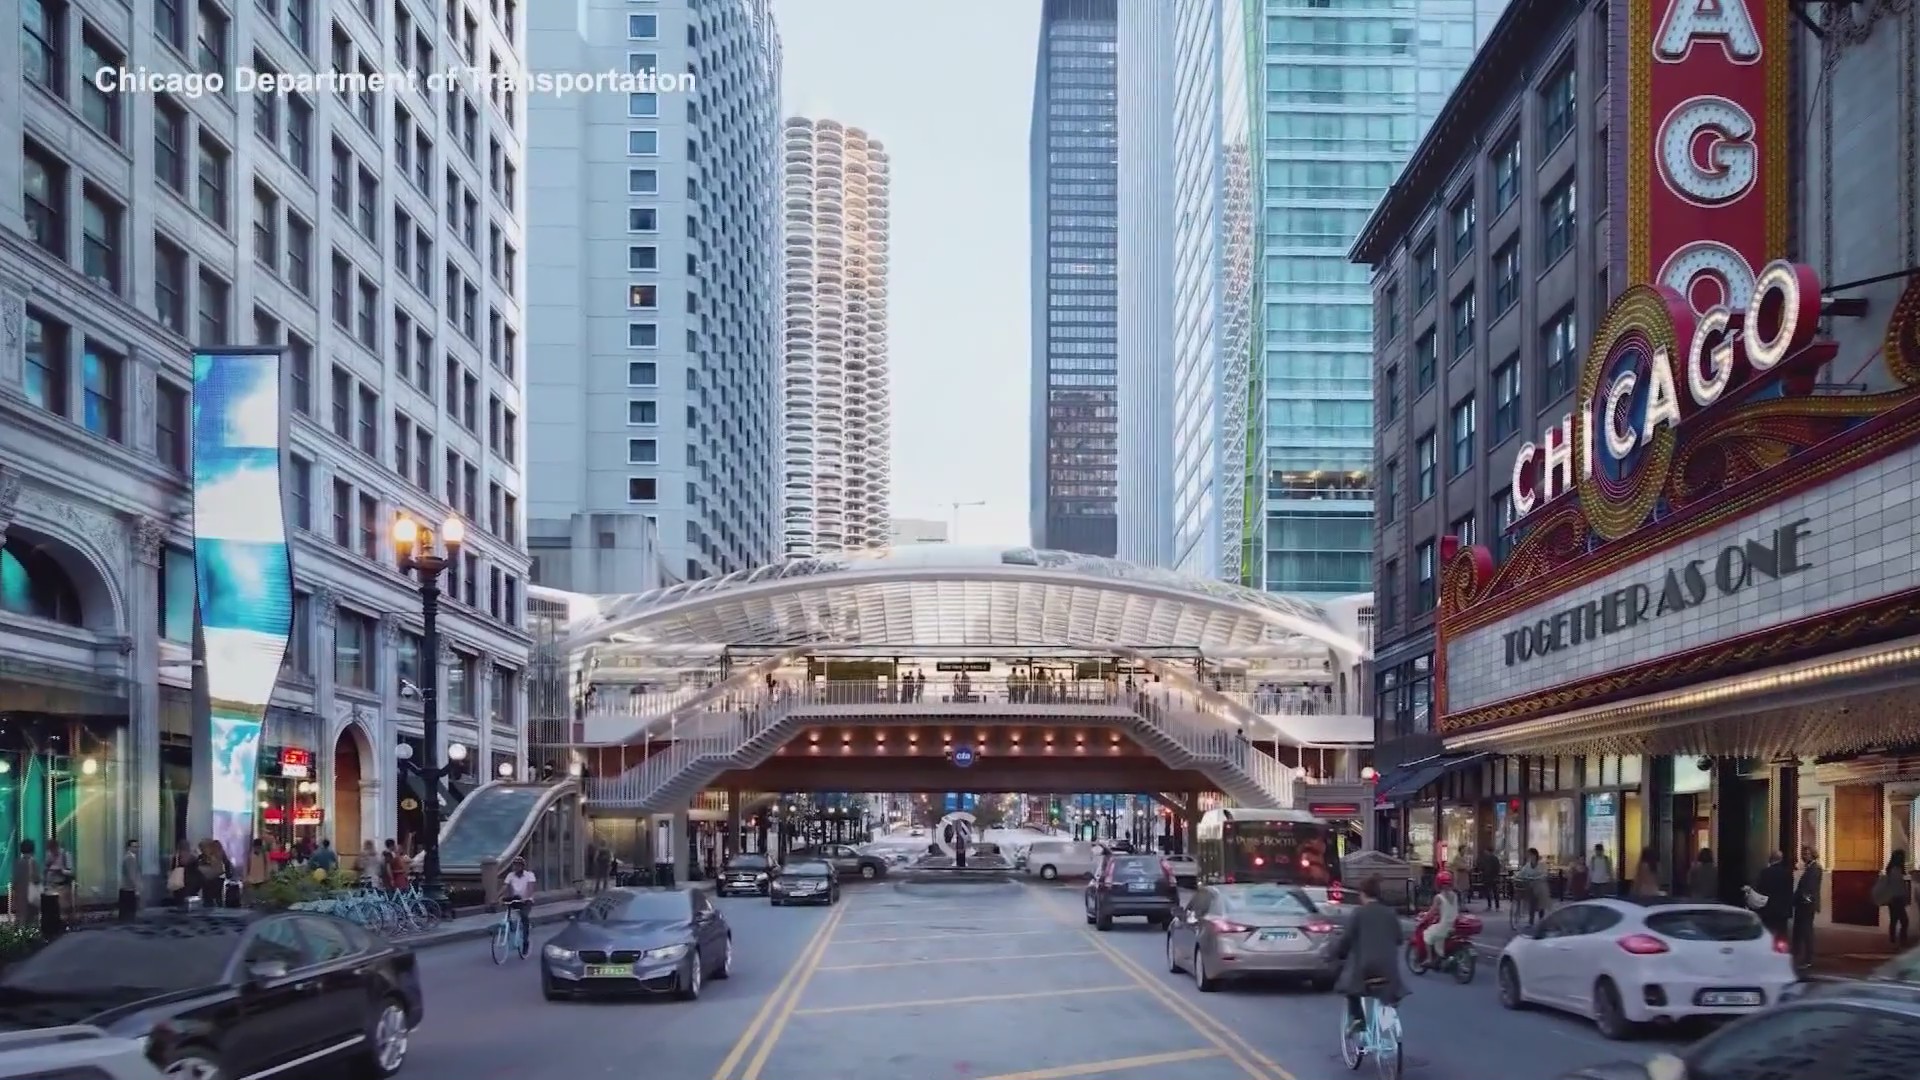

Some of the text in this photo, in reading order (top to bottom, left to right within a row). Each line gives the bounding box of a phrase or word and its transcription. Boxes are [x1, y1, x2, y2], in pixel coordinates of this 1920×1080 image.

[1511, 258, 1801, 517] CHICAGO
[1502, 517, 1813, 667] TOGETHER AS ONE
